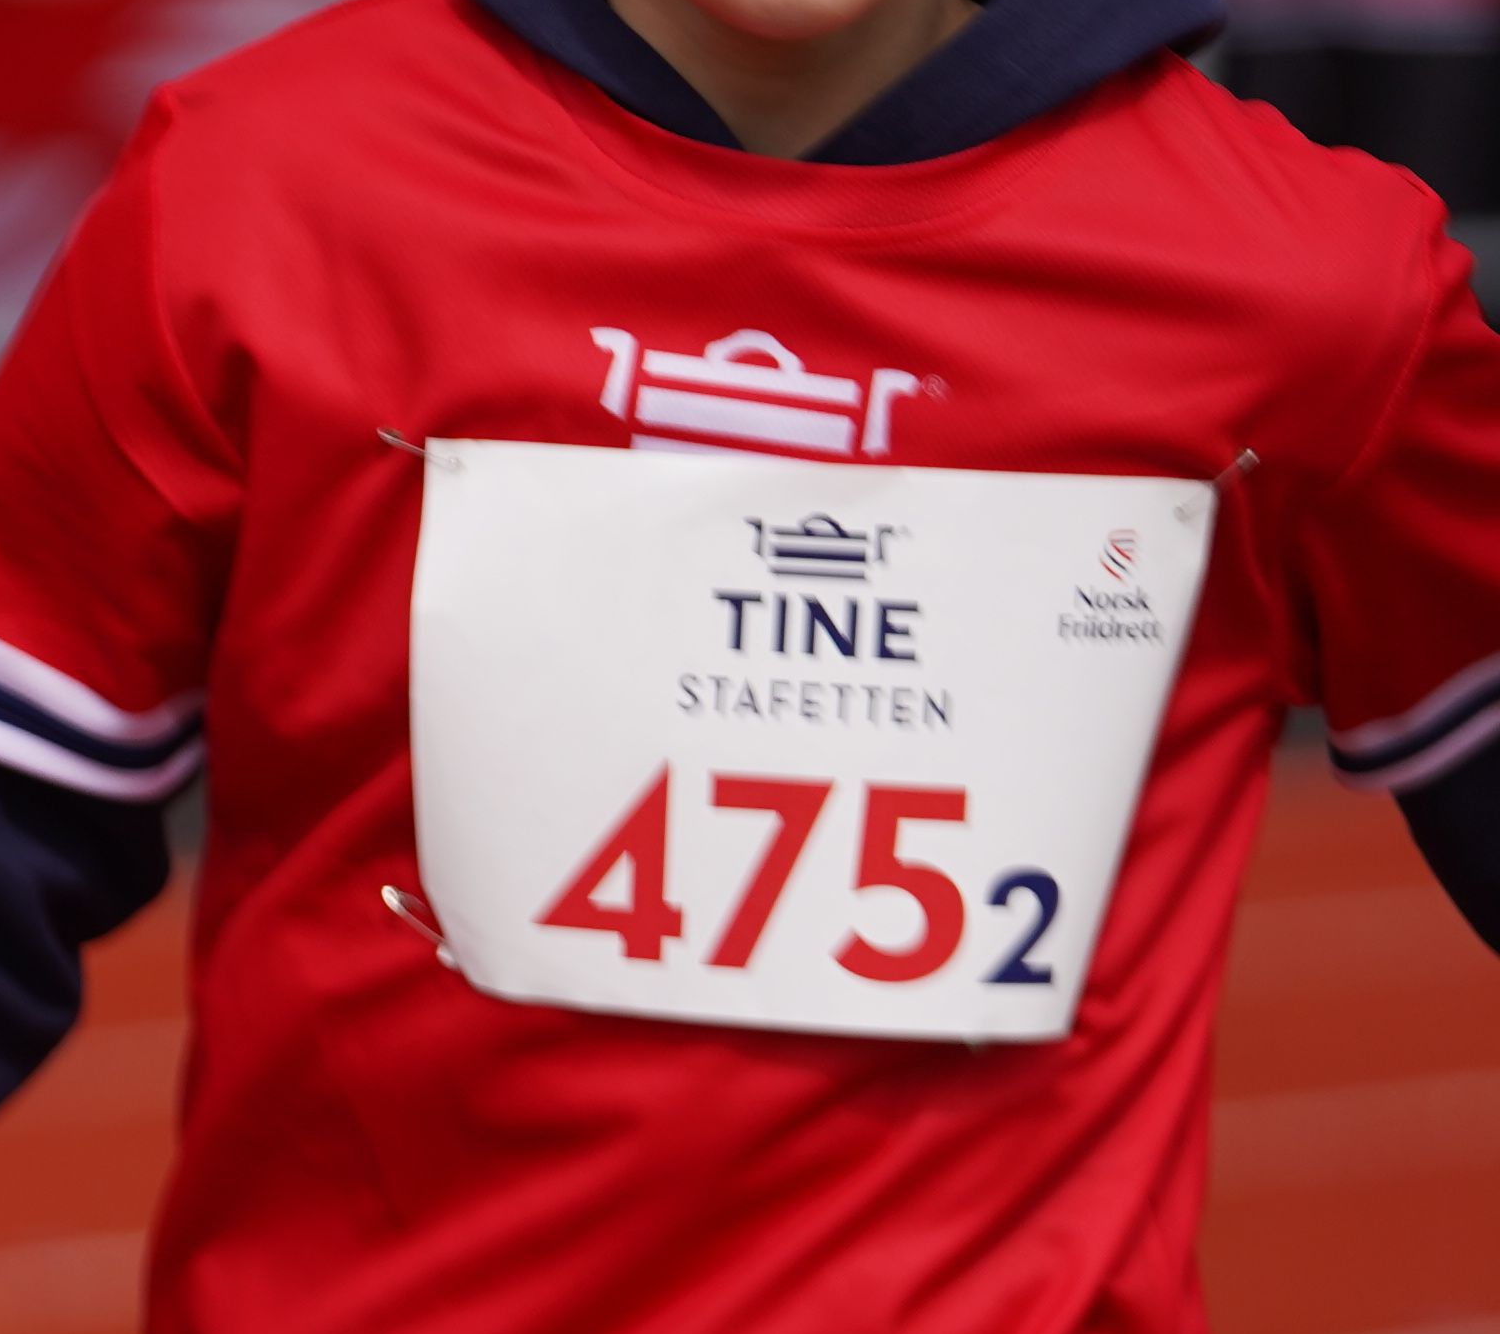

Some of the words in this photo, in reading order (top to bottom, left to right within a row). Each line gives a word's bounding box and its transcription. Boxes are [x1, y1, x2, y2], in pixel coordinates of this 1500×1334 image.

[713, 588, 920, 662] TINE
[1074, 585, 1151, 610] Norsk
[1058, 613, 1162, 641] Friidrett
[677, 672, 953, 730] STAFETTEN
[534, 759, 968, 984] 475
[981, 868, 1062, 985] 2
